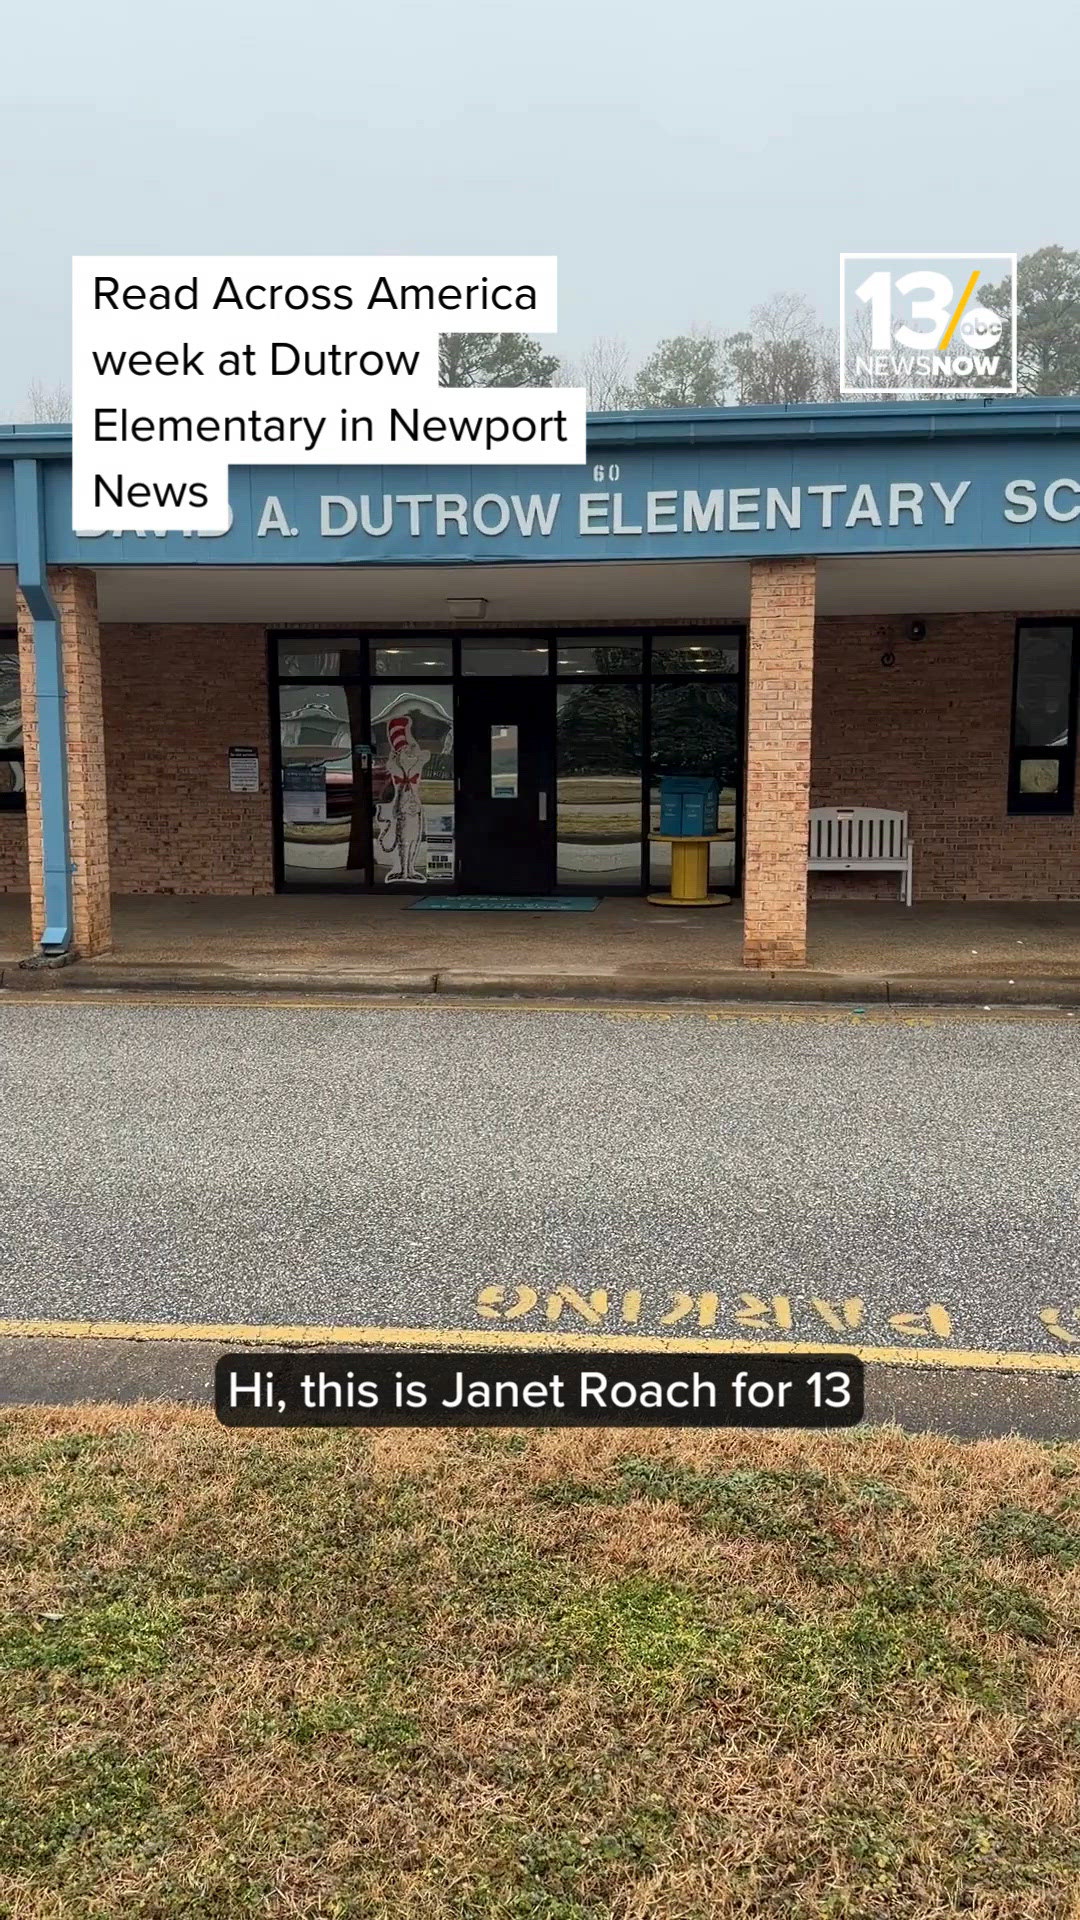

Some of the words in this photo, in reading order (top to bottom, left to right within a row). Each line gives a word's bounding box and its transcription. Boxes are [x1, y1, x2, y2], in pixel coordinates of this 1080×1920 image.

[593, 464, 620, 482] 60
[257, 495, 299, 537] A.
[321, 493, 560, 537] DUTROW
[579, 480, 972, 536] ELEMENTARY
[474, 1284, 953, 1339] PARKING
